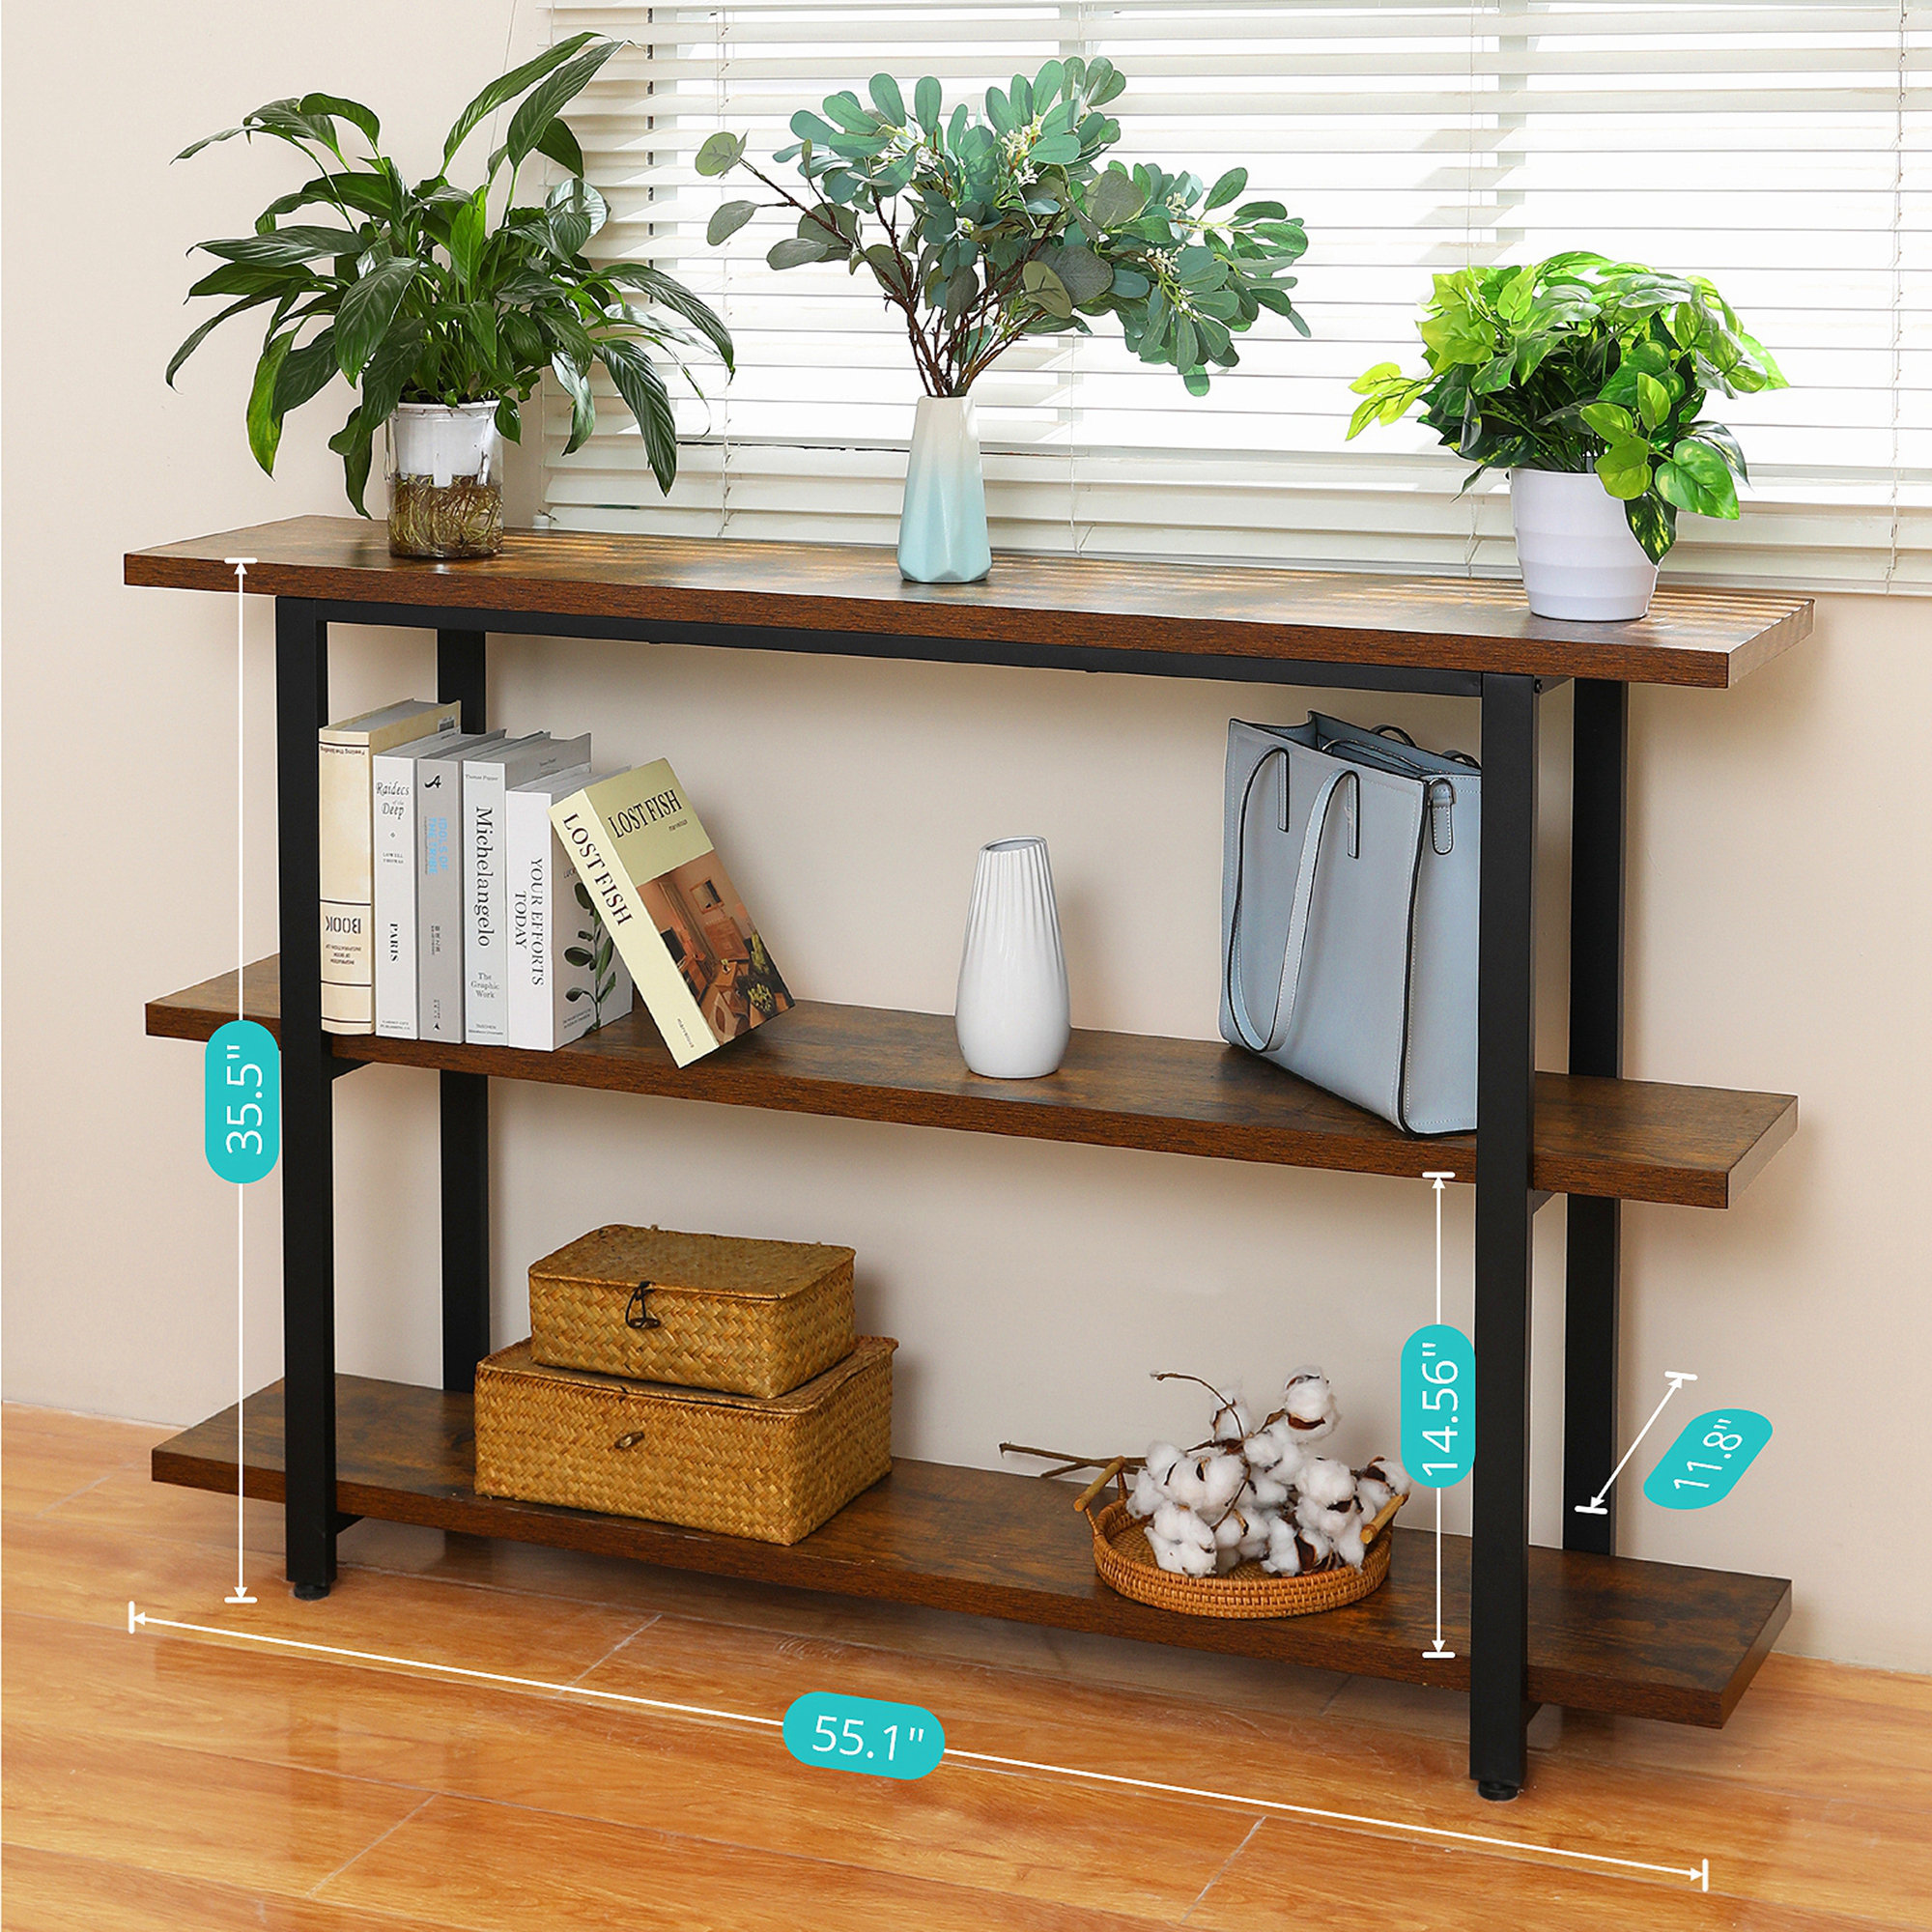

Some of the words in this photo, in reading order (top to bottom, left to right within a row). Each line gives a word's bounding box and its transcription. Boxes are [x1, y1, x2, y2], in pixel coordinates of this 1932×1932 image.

[382, 803, 404, 820] Deep
[608, 803, 648, 838] LOST
[644, 789, 682, 821] FISH
[438, 816, 448, 853] IDOLS
[438, 854, 449, 870] OF
[473, 807, 495, 947] Michelangelo
[530, 858, 543, 905] YOUR
[562, 812, 606, 869] LOST
[594, 871, 634, 925] FISH
[326, 916, 361, 934] BOOK
[515, 891, 526, 950] TODAY
[389, 923, 399, 962] PARIS
[531, 911, 544, 986] EFFORTS
[470, 980, 500, 990] Graphic
[475, 989, 495, 998] Work
